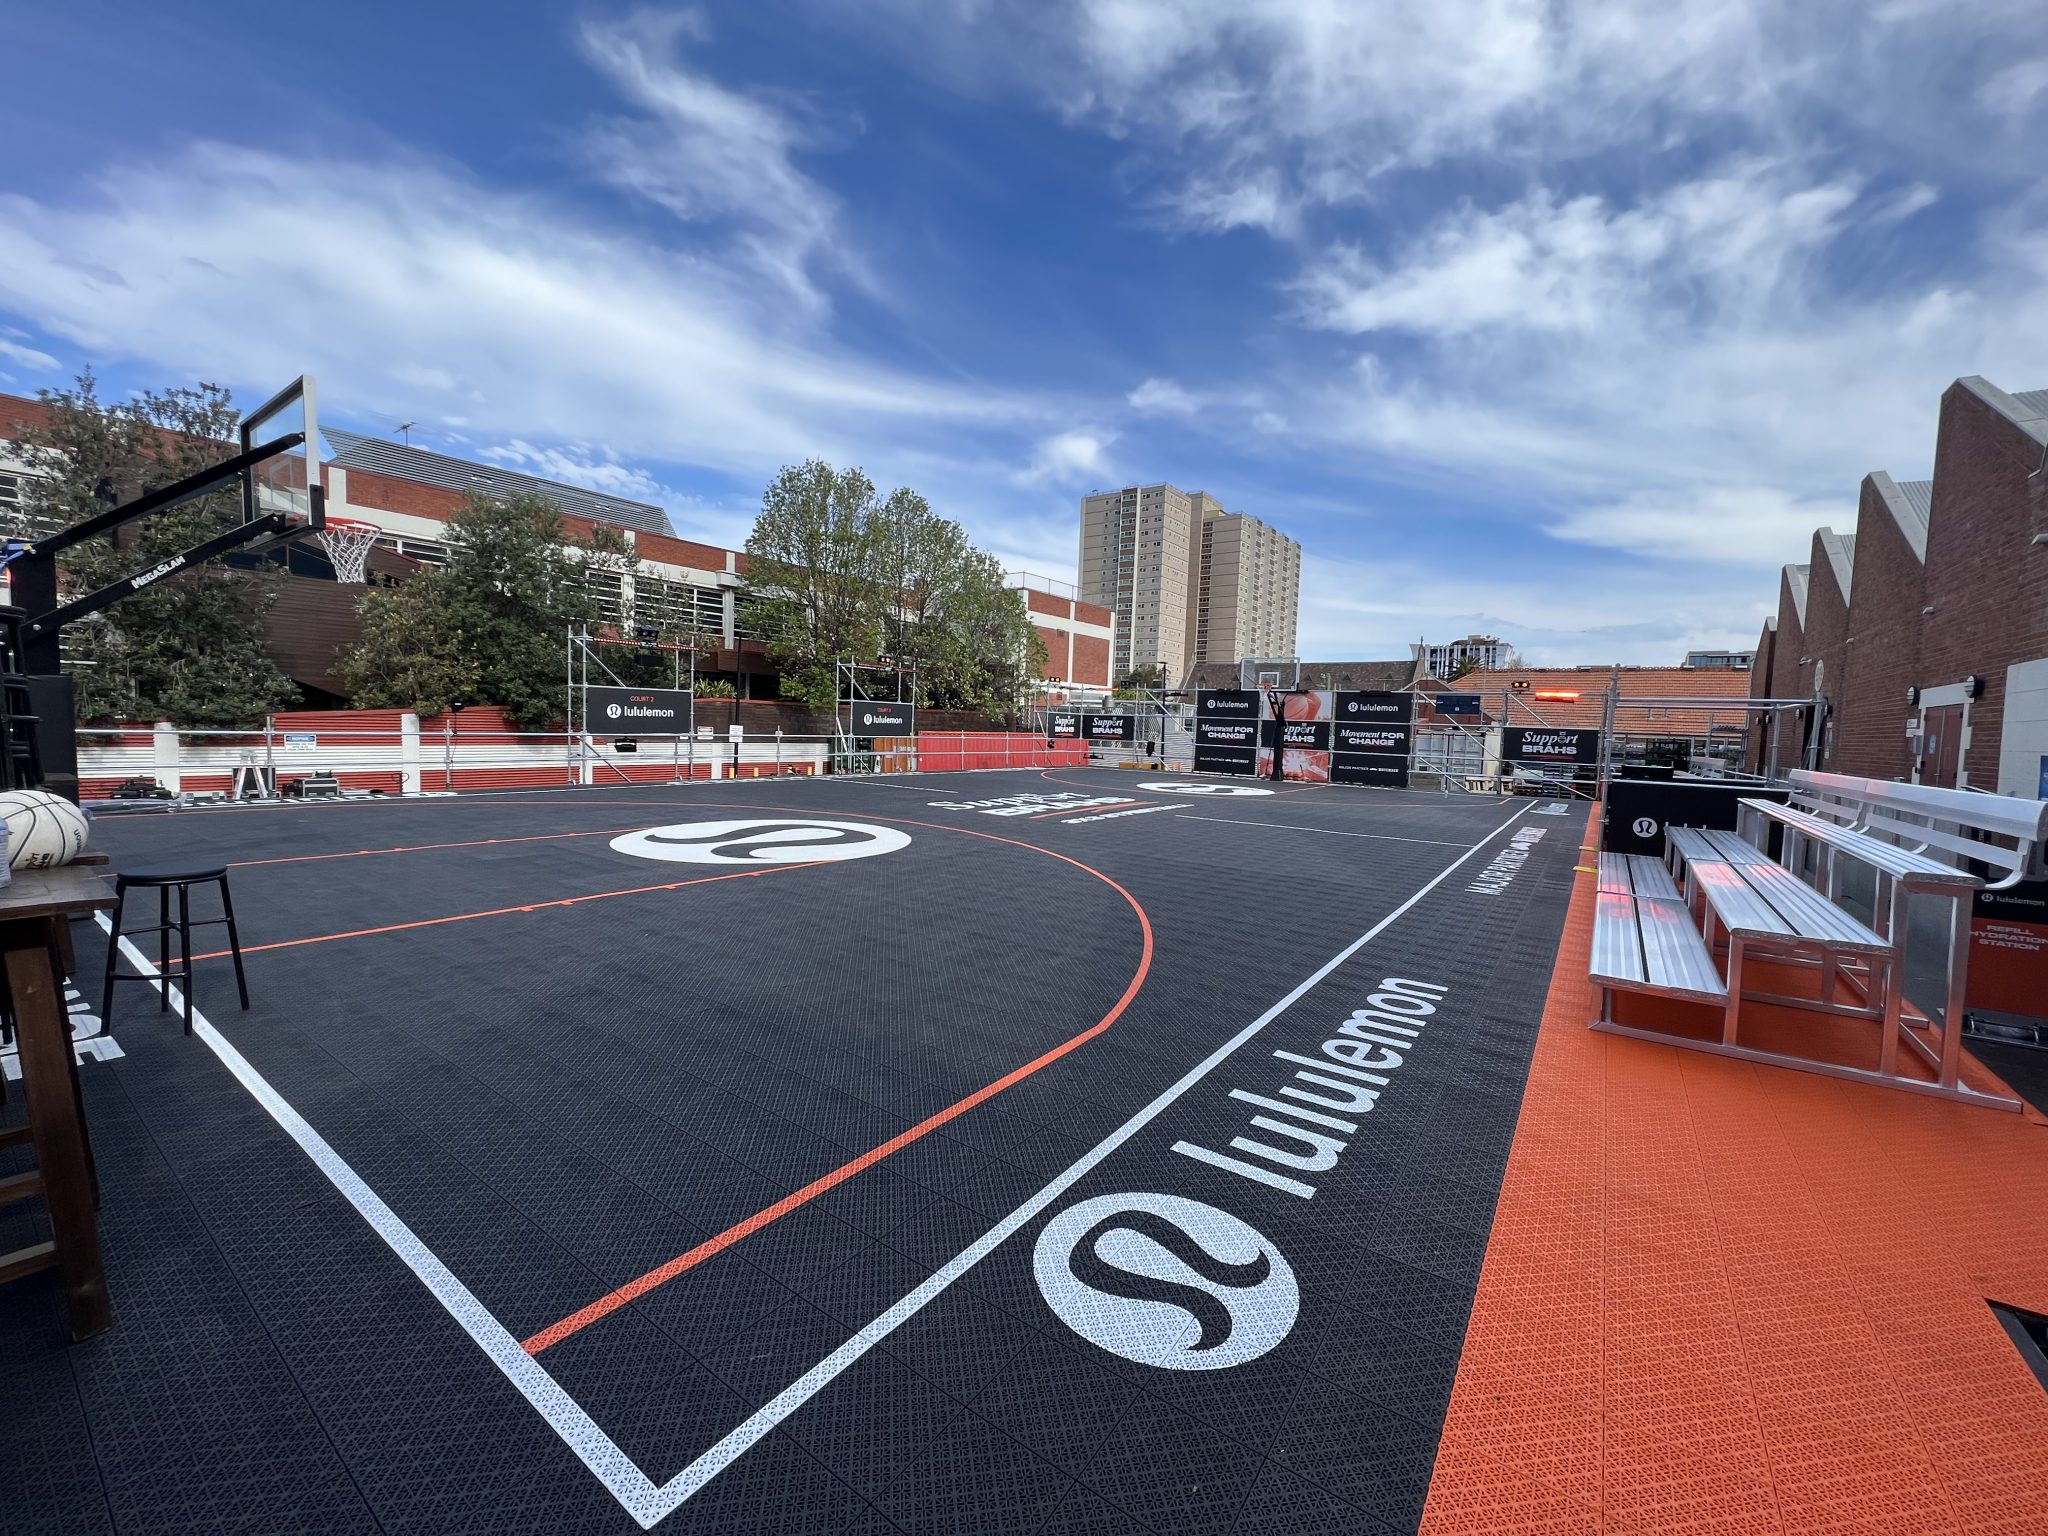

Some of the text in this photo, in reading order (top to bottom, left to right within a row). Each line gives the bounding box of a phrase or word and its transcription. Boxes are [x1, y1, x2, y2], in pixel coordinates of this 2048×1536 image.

[624, 706, 674, 717] lululemon
[1360, 704, 1398, 712] lululemon
[873, 715, 903, 724] lululemon
[1093, 717, 1124, 727] Support
[1201, 724, 1233, 732] Movement
[1284, 722, 1316, 735] pport
[1340, 729, 1380, 738] Movement
[1522, 731, 1579, 745] Support
[1283, 735, 1316, 743] RAHS
[1348, 738, 1395, 746] CHANGE
[1522, 744, 1578, 754] BRAHS
[1996, 895, 2046, 907] lululemon
[1986, 924, 2034, 935] REFILL
[1978, 938, 2040, 951] STATION
[1170, 977, 1449, 1200] lululemon
